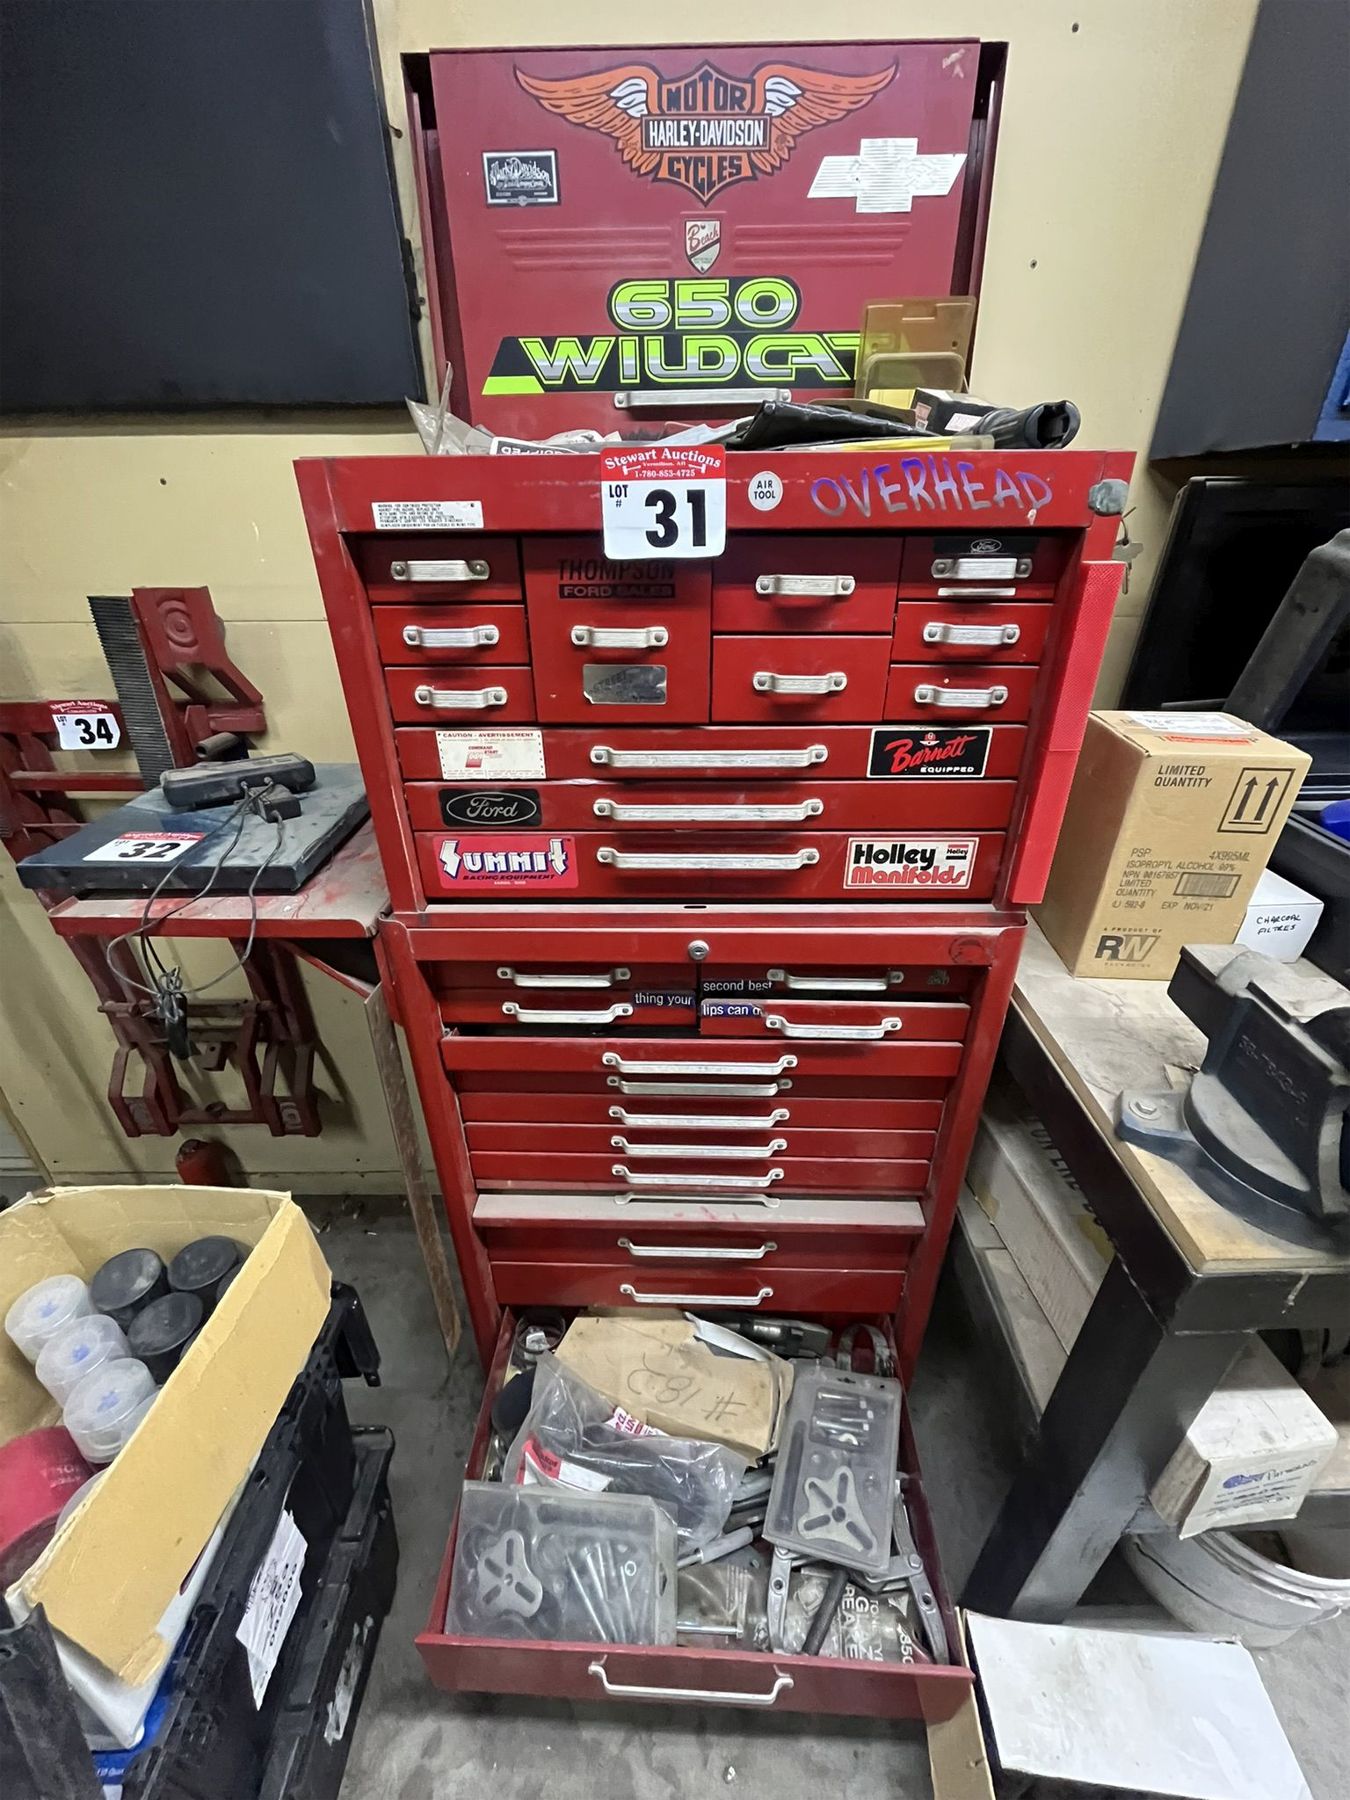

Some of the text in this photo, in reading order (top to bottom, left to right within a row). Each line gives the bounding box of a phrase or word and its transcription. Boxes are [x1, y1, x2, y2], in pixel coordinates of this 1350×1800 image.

[667, 69, 747, 112] MOTOR
[649, 119, 765, 147] HARLEY-DAVIDSON
[667, 155, 743, 197] CYCLES
[612, 277, 799, 331] 650
[604, 447, 722, 470] Stewart Auctions
[635, 469, 696, 478] 1-780-853-4725
[609, 484, 629, 498] LOT
[757, 480, 773, 489] AIR
[809, 455, 1053, 518] OVERHEAD
[753, 490, 776, 500] TOOL
[615, 499, 622, 508] #
[644, 488, 707, 549] 31
[558, 558, 676, 581] THOMPSON
[563, 586, 612, 597] FORD
[74, 717, 114, 745] 34
[884, 735, 978, 774] Barnett
[1158, 765, 1207, 776] LIMITED
[1154, 776, 1213, 788] QUANTITY
[466, 796, 519, 818] Ford
[118, 842, 182, 858] 32
[853, 844, 937, 871] Holley
[1130, 848, 1152, 858] PSP
[1126, 860, 1173, 869] ISOPROPYL
[1175, 861, 1214, 871] ALCOHOL
[850, 864, 966, 884] Manifolds
[1119, 879, 1152, 887] LIMITED
[1115, 888, 1157, 897] QUANTITY
[1161, 901, 1180, 910] EXP
[1095, 934, 1160, 962] RW
[703, 979, 773, 991] second best
[635, 992, 693, 1007] thing your
[703, 1004, 724, 1017] lips
[727, 1006, 749, 1016] can
